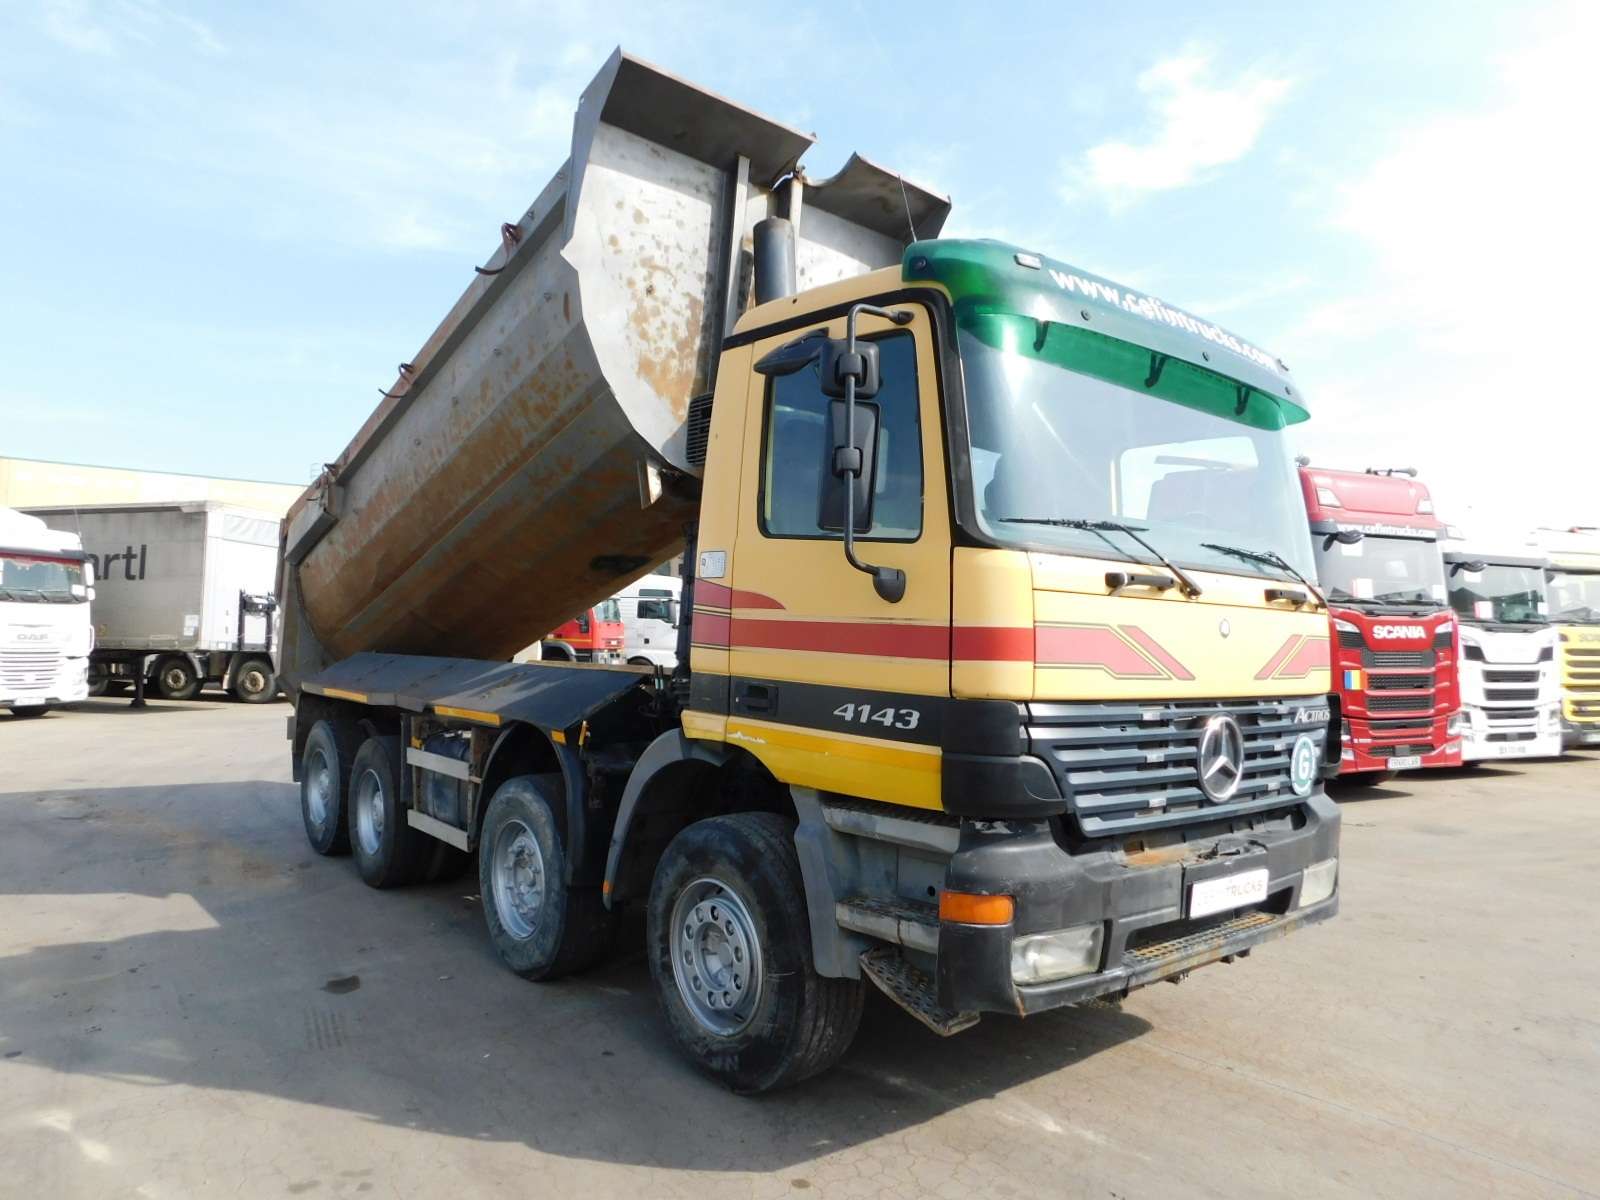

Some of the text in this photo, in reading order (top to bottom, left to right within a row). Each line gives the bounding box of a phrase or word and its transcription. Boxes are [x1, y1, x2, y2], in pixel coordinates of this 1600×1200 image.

[17, 633, 48, 641] DAF
[1372, 625, 1427, 639] SCANIA
[833, 703, 921, 730] 4143
